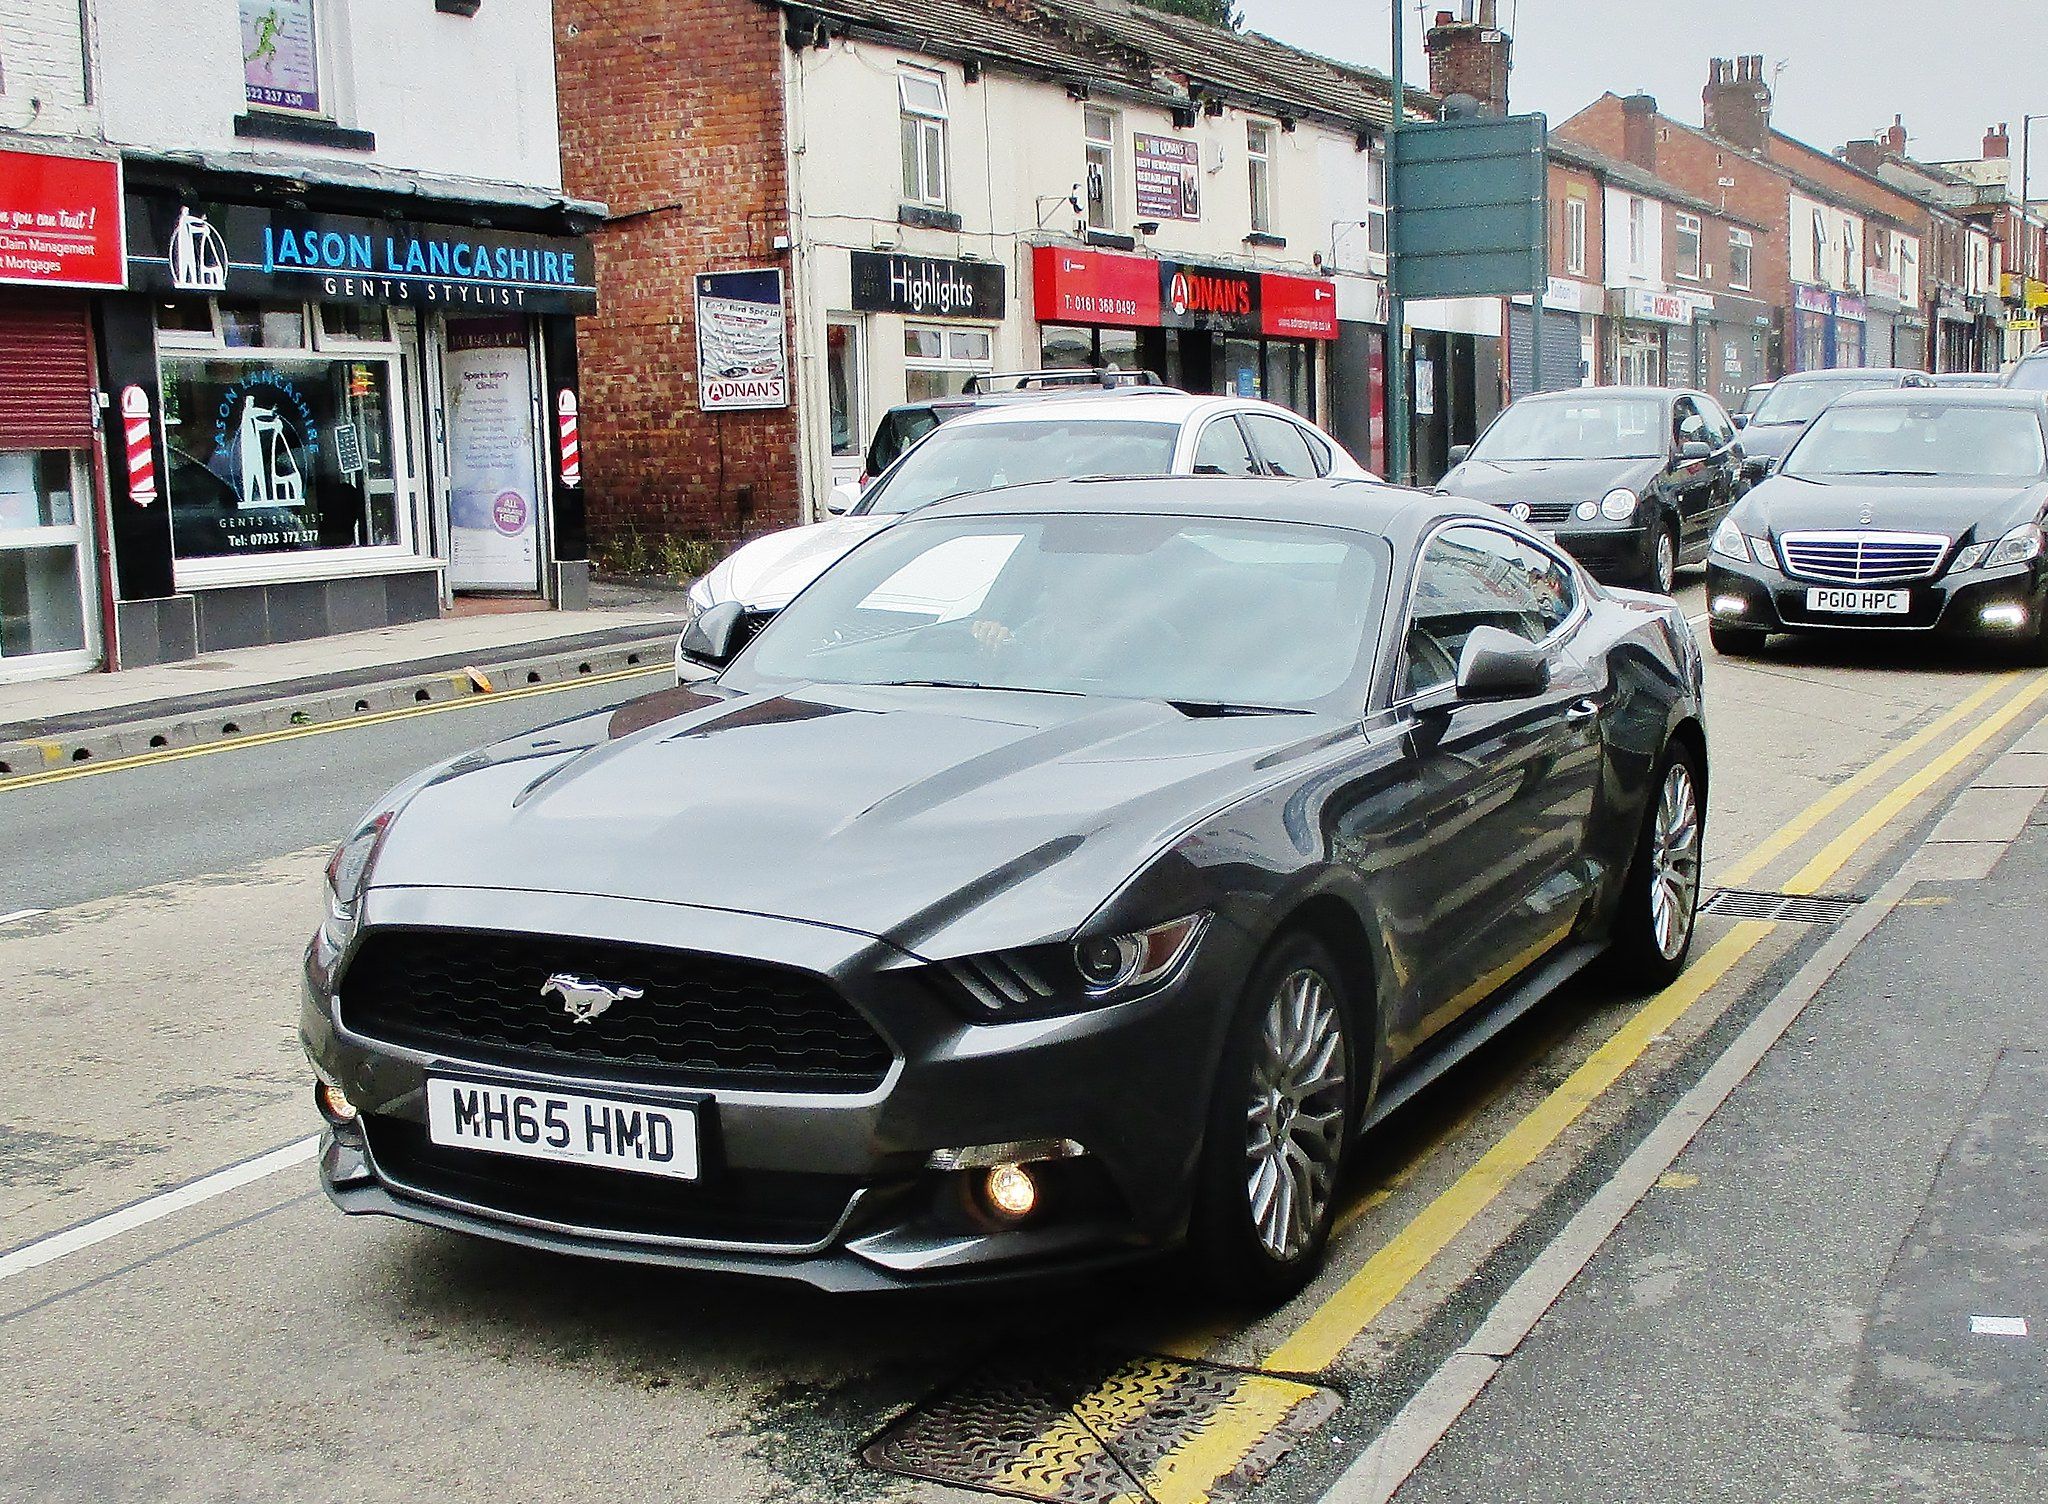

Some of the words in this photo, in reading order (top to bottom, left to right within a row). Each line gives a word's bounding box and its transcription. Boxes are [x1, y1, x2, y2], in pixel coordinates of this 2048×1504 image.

[11, 211, 34, 230] you
[37, 213, 57, 227] can
[0, 236, 28, 250] Claim
[29, 239, 95, 256] Management
[263, 227, 373, 274] JASON
[386, 237, 576, 284] LANCASHIRE
[6, 256, 61, 274] Mortgages
[324, 276, 408, 300] GENTS
[427, 285, 526, 306] STYLIST
[889, 260, 973, 312] Highlights
[705, 301, 727, 312] Early
[729, 303, 747, 313] Bird
[749, 306, 781, 319] Special
[1065, 295, 1073, 310] T:
[1075, 296, 1095, 311] 0161
[1098, 298, 1115, 314] 368
[1116, 300, 1136, 316] 0492
[709, 381, 779, 402] ADNAN'S
[218, 516, 264, 529] GENTS
[228, 534, 249, 547] Tel:
[250, 532, 280, 546] 07935
[1817, 591, 1857, 609] PG10
[1862, 592, 1898, 610] HPC
[453, 1087, 571, 1149] MH65
[584, 1103, 674, 1163] HMD
